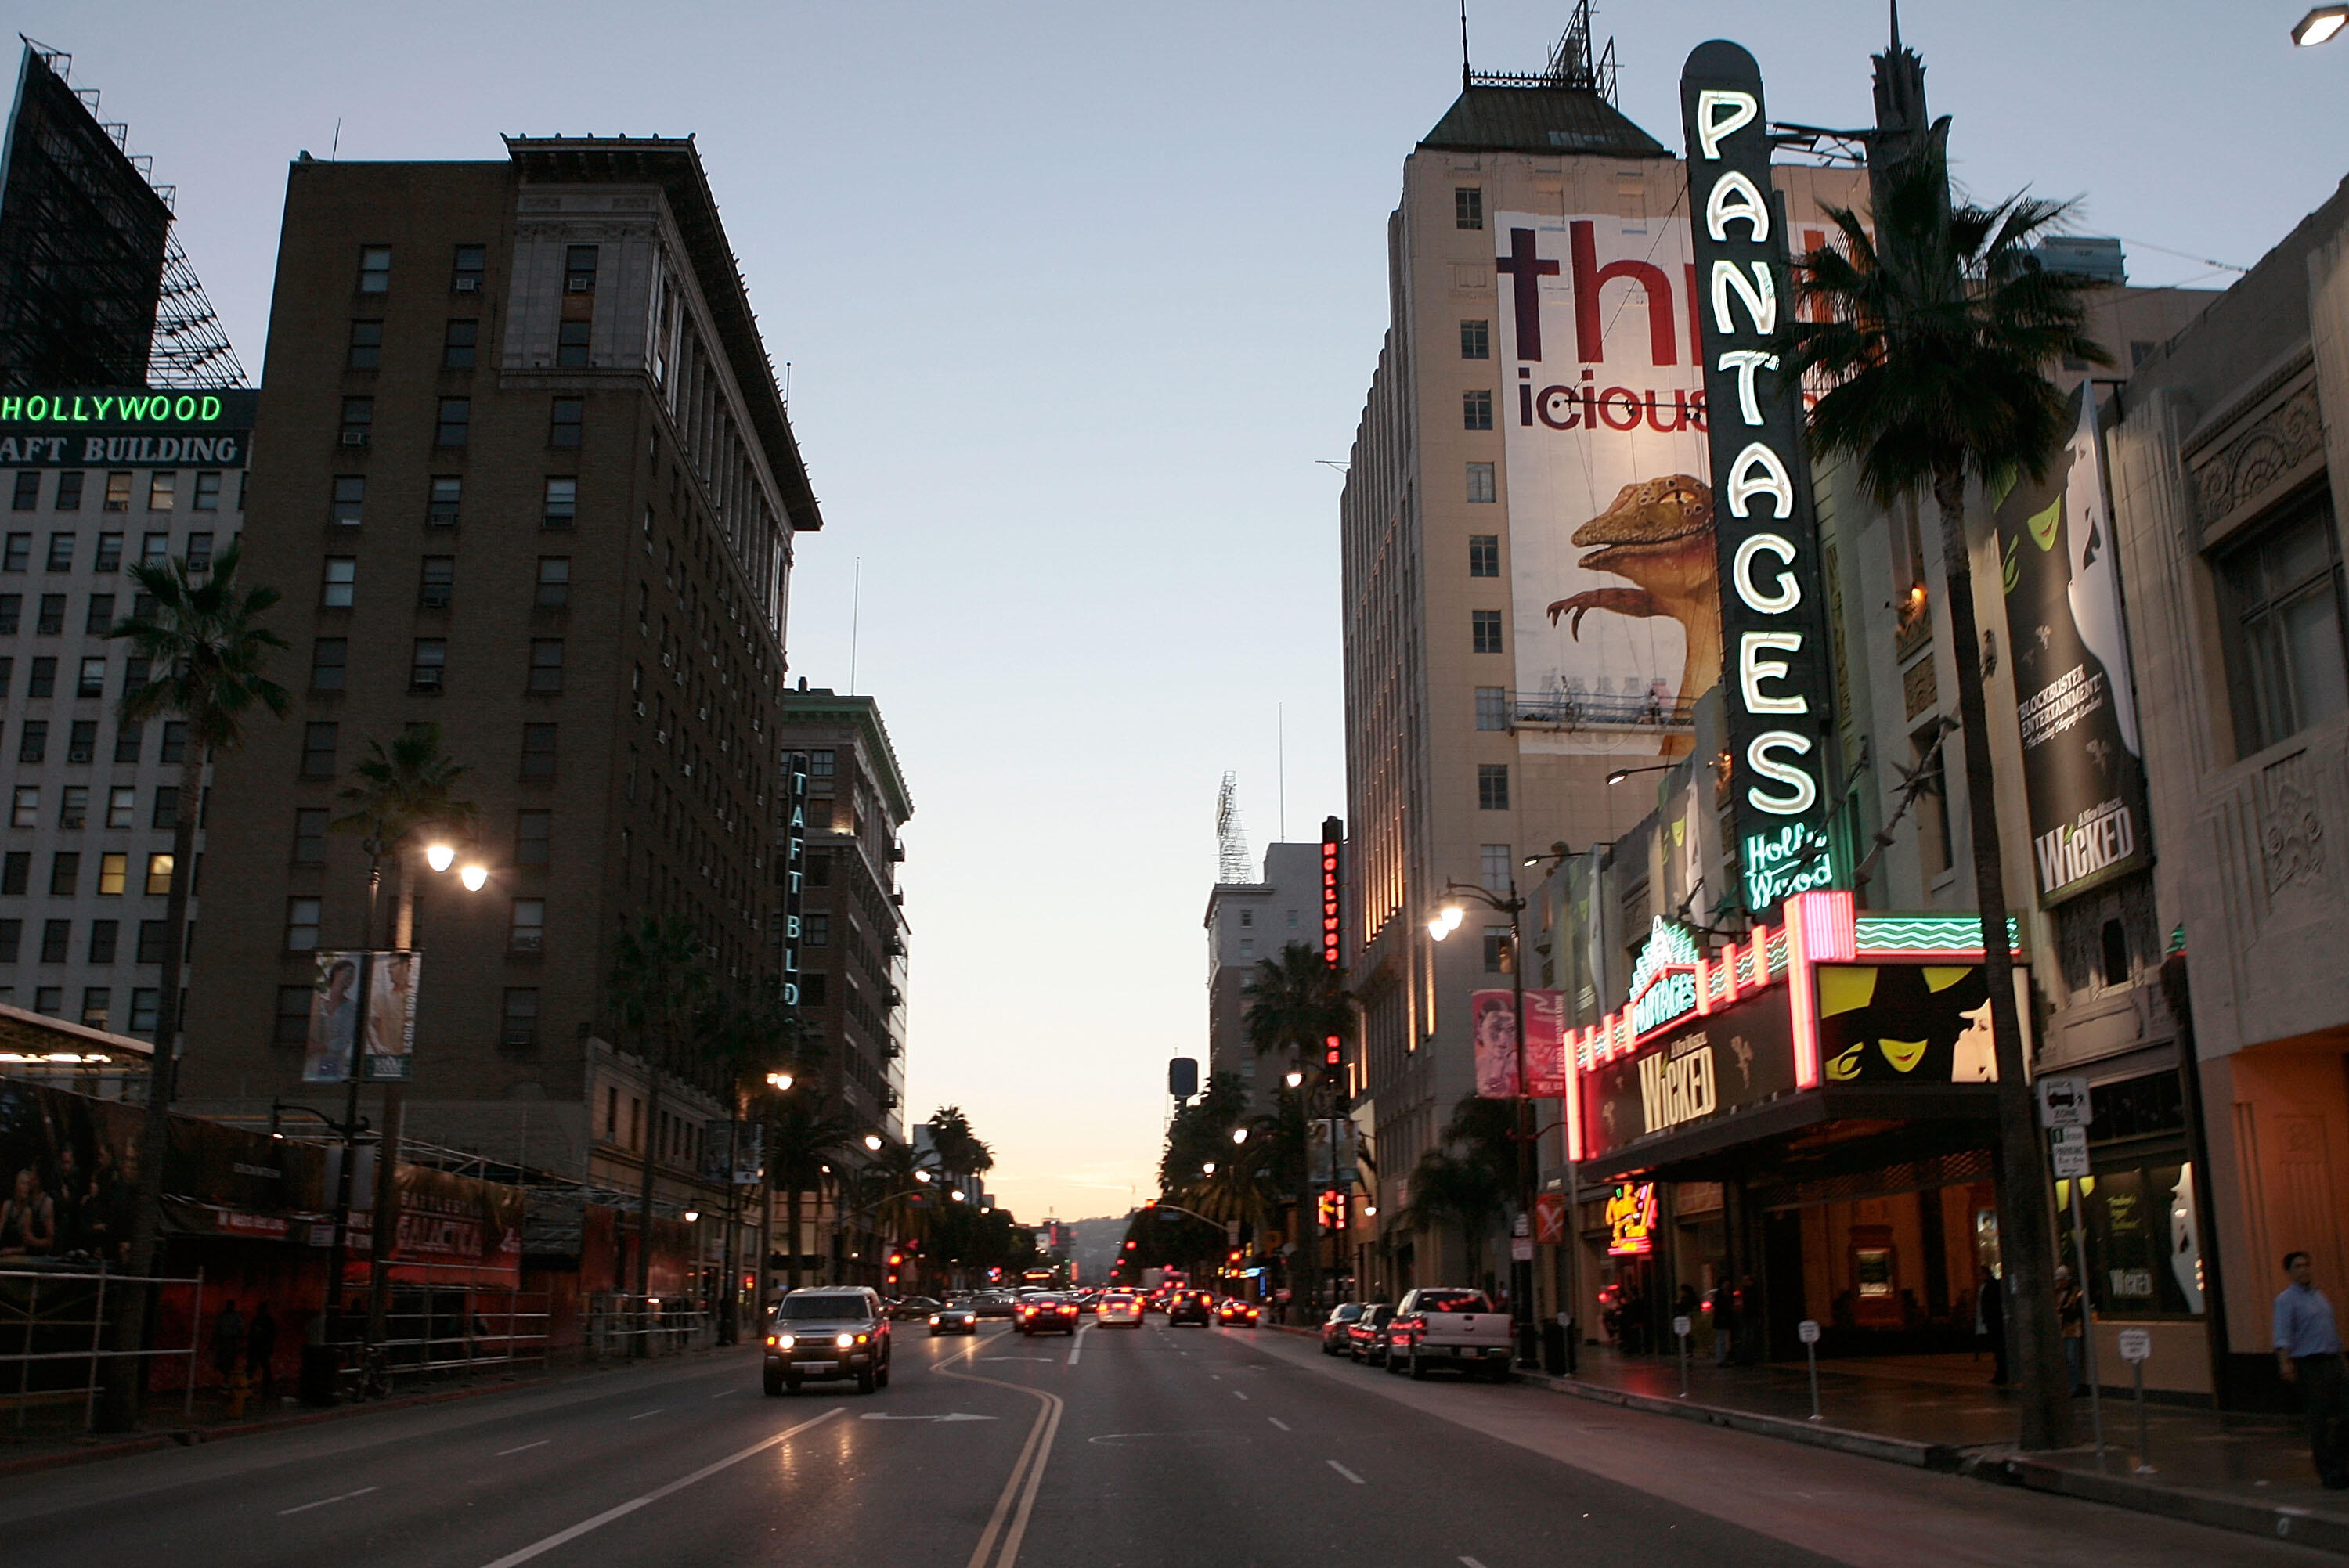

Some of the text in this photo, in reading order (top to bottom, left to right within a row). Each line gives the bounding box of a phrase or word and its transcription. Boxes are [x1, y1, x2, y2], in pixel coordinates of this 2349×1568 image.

[0, 436, 238, 463] AFT BUILDING
[1, 395, 223, 422] HOLLYWOOD
[1698, 90, 1816, 815] PANTAGES
[785, 771, 806, 1022] TAFT BLD
